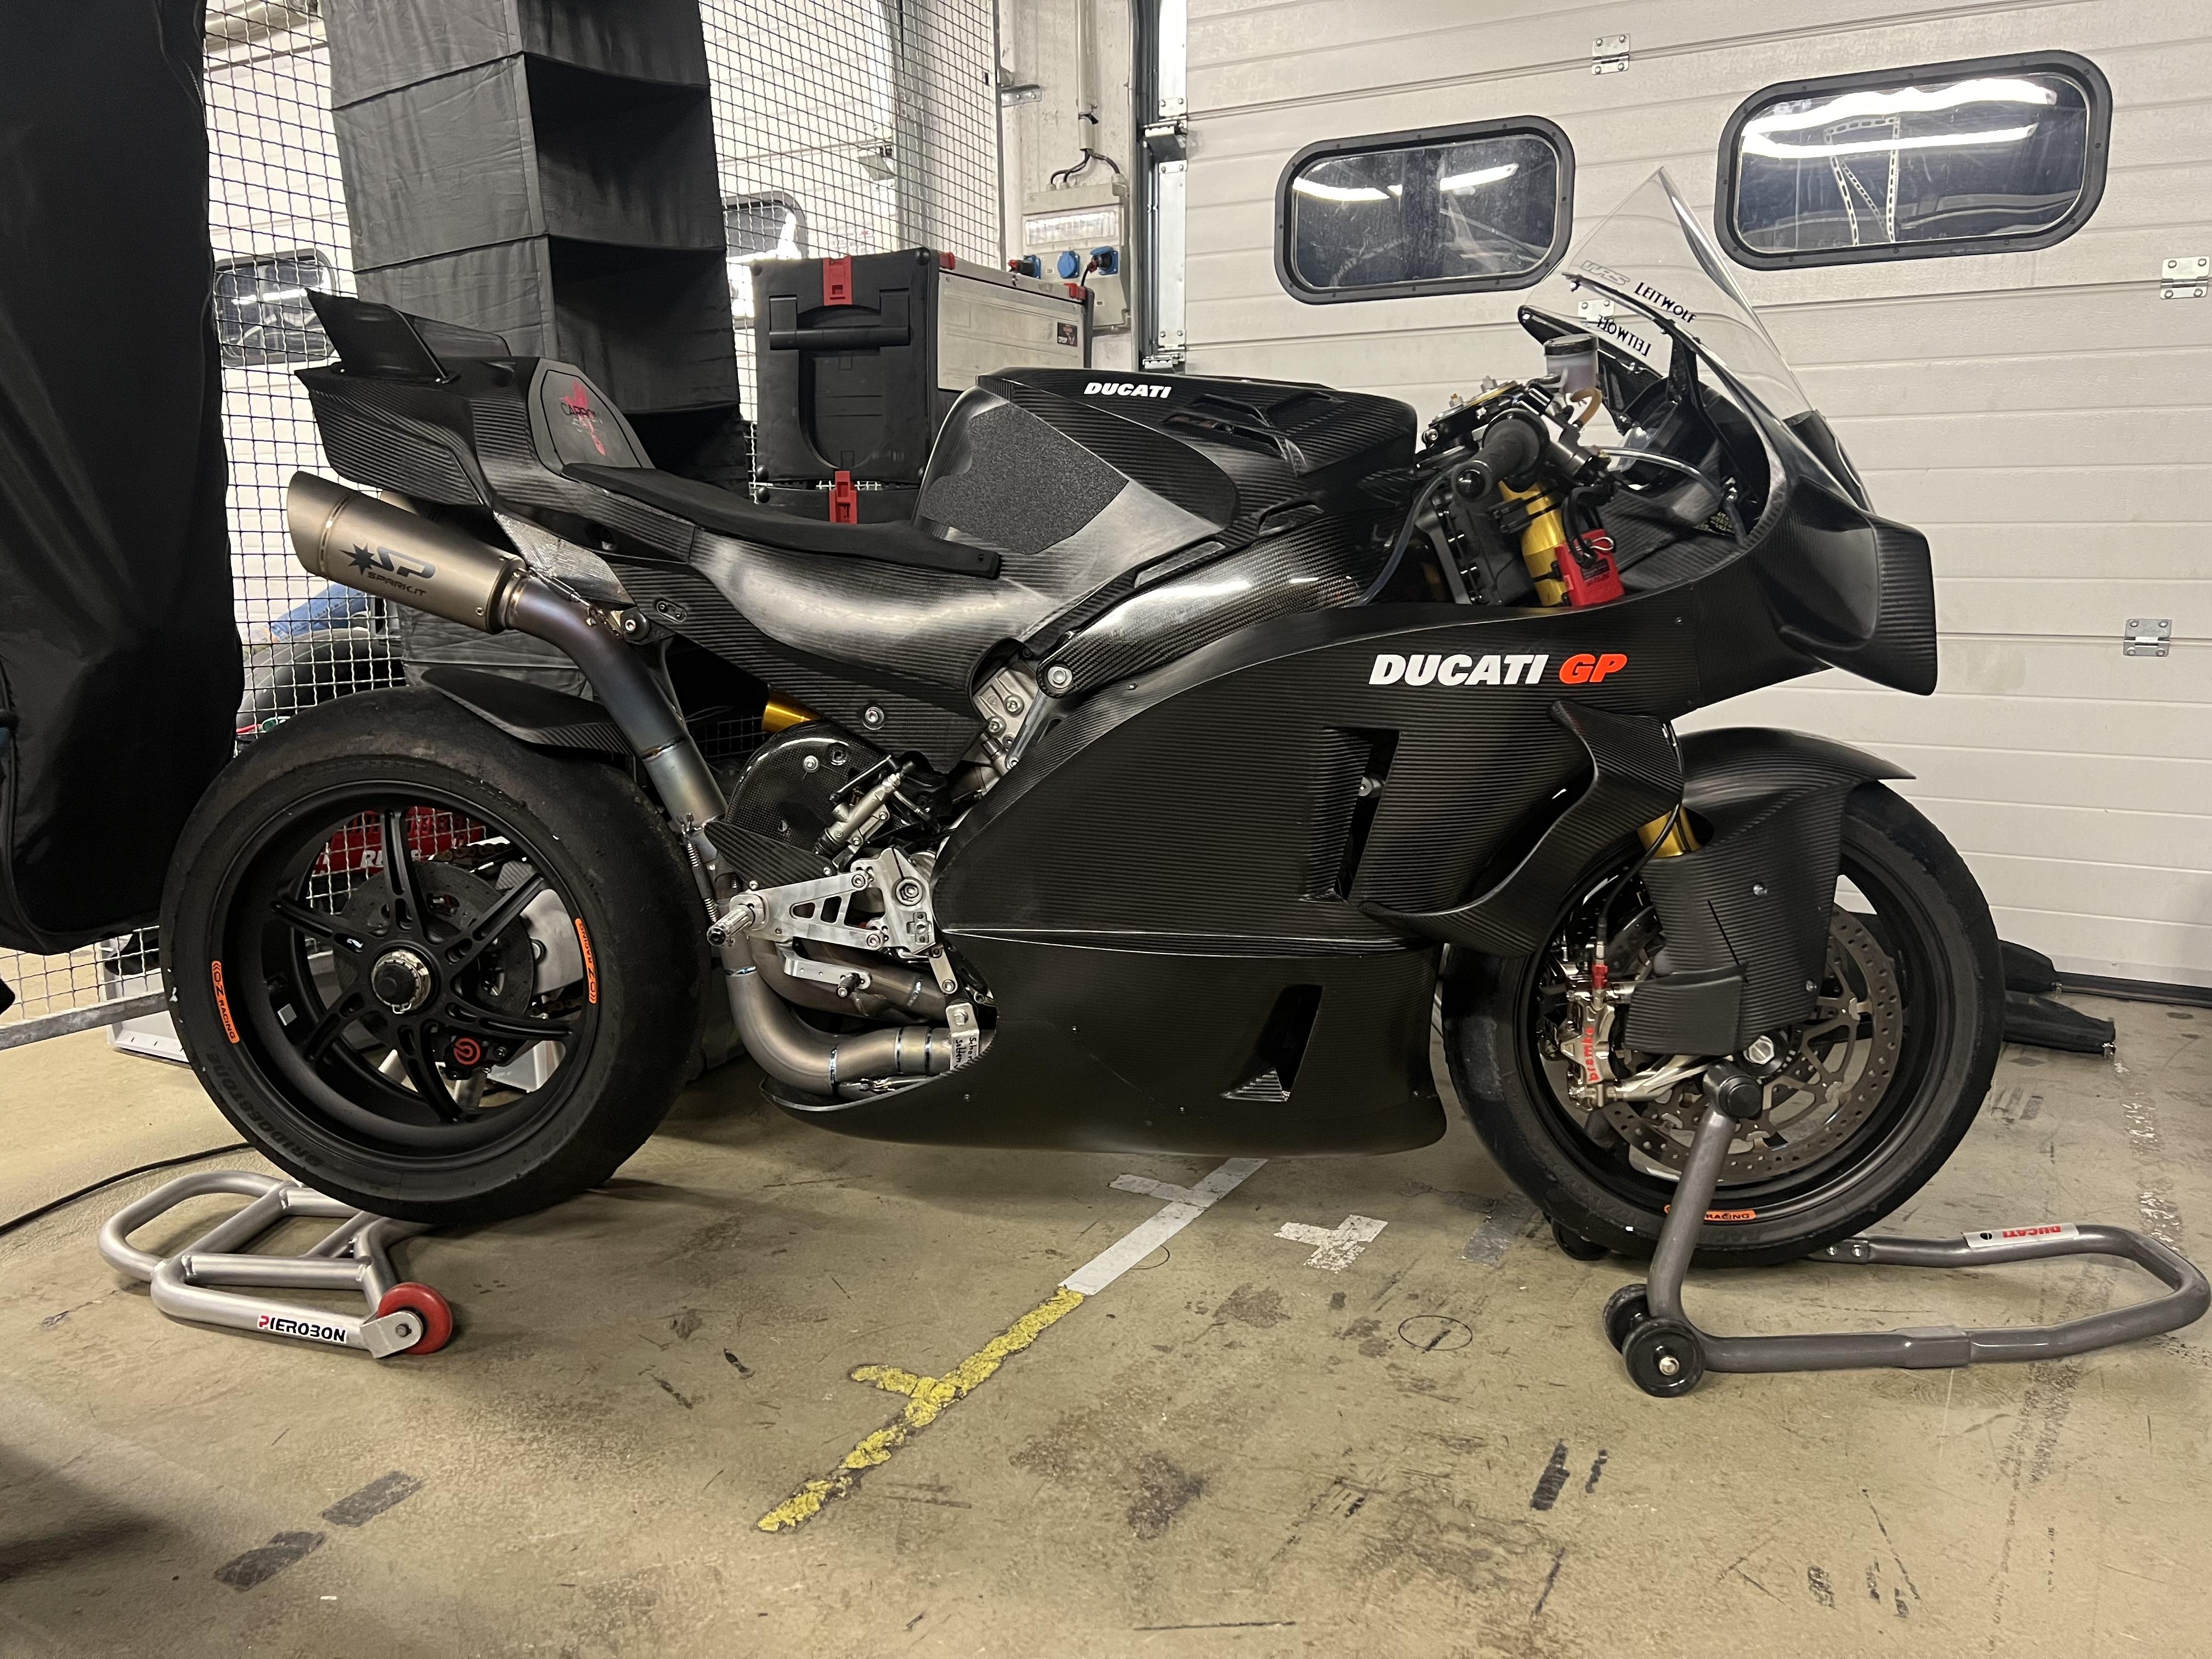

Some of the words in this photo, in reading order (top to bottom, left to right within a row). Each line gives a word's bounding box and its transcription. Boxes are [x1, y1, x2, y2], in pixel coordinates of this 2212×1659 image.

[1634, 282, 1697, 323] LEITWOLF
[1084, 382, 1172, 398] DUCATI
[1368, 654, 1549, 686] DUCATI
[1559, 654, 1628, 684] GP
[579, 923, 592, 963] RACING
[219, 1000, 236, 1039] RACING
[1581, 1026, 1599, 1081] brembo
[2002, 1225, 2061, 1238] DUCATI
[258, 1315, 346, 1342] PIEROBON
